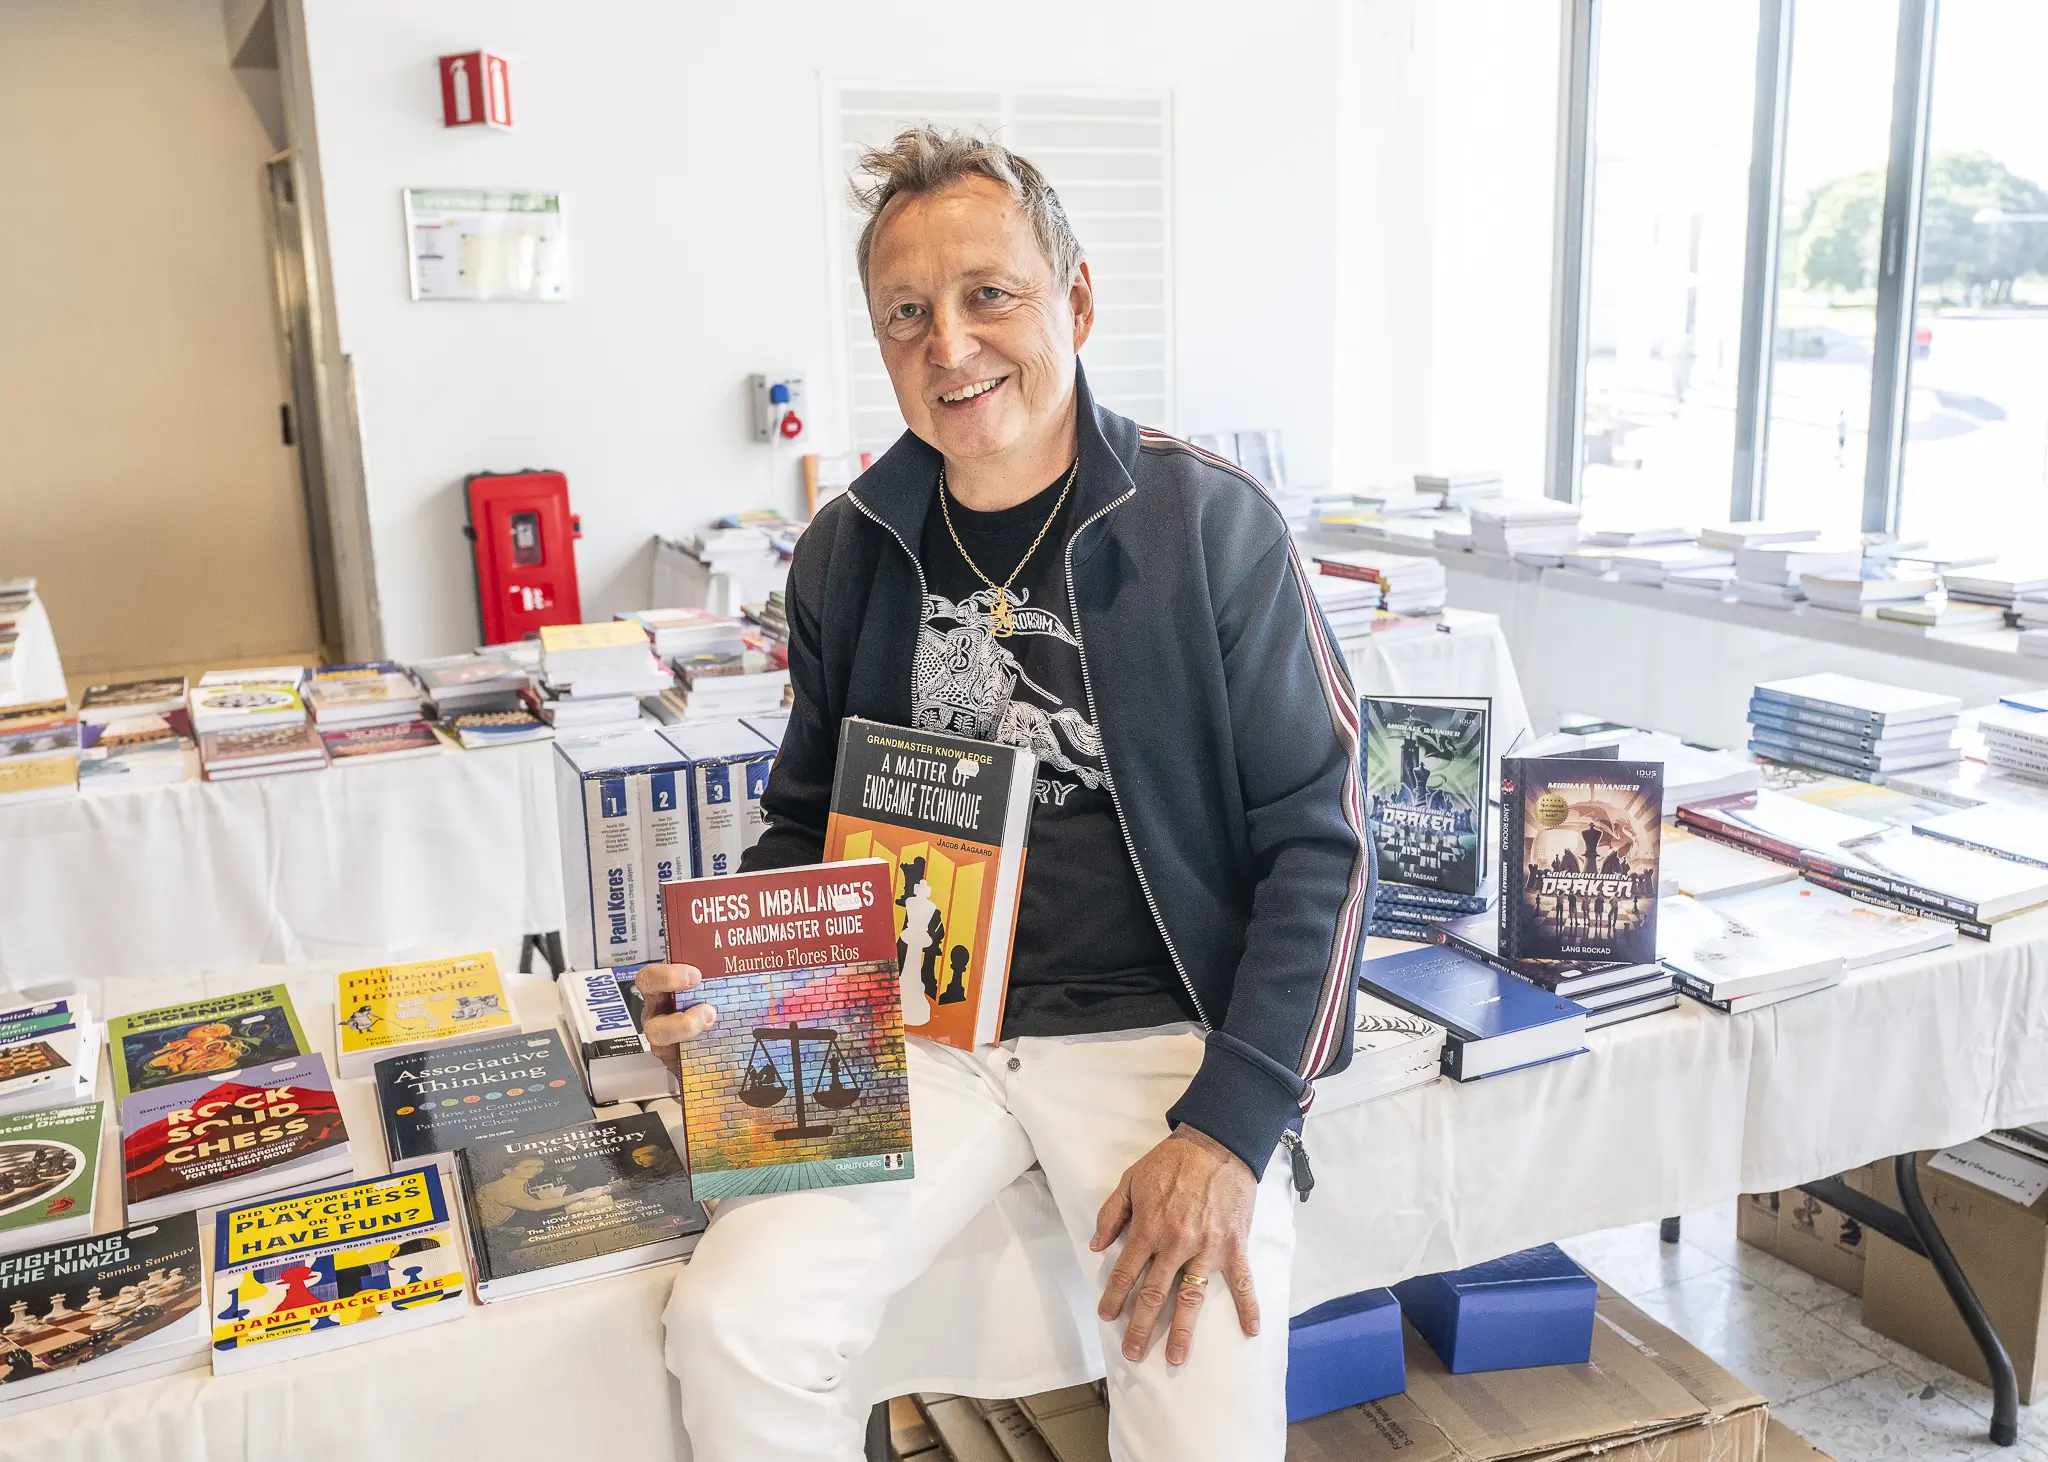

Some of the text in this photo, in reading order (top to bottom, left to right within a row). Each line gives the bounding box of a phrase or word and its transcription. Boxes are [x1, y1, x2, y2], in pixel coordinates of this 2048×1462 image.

[1003, 611, 1053, 632] RORSUM
[1387, 722, 1461, 738] MICHAEL WIANDER
[867, 734, 993, 765] GRANDMASTER KNOWLEDGE
[881, 752, 890, 772] A
[895, 755, 947, 784] MATTER
[658, 791, 669, 808] 2
[713, 784, 724, 801] 3
[753, 779, 764, 795] 4
[1547, 782, 1640, 792] MICHAEL WIANDER
[607, 797, 618, 814] 1
[862, 775, 982, 830] ENDGAME TECHNIQUE
[1382, 808, 1455, 833] DRAKEN
[625, 862, 633, 882] players
[1404, 871, 1438, 883] EN PASSANT
[626, 883, 634, 898] chess
[1398, 893, 1427, 902] MICHAEL
[1541, 878, 1634, 898] DRAKEN
[1844, 868, 1891, 892] Understanding
[1890, 882, 1909, 896] Rook
[1909, 888, 1945, 907] Endgames
[607, 868, 628, 945] Paul Keres
[628, 899, 636, 913] other
[691, 893, 750, 925] CHESS
[1392, 910, 1421, 919] MICHAEL
[1851, 890, 1956, 925] Understanding Rook Endgames
[714, 915, 864, 949] A GRANDMASTER GUIDE
[1392, 928, 1421, 937] MICHAEL
[724, 944, 860, 974] Mauricio Flores Rios
[1562, 945, 1611, 955] LÅNG ROCKAD
[348, 962, 489, 989] Philosopher
[375, 978, 439, 992] and the
[352, 980, 480, 1003] Housewife
[584, 973, 623, 1007] Keres
[127, 989, 273, 1023] LEARN FROM THE
[127, 1000, 256, 1029] LEGENDS
[590, 1004, 633, 1032] Paul
[393, 1050, 551, 1085] Associative
[395, 1052, 448, 1066] MIKHAIL
[407, 1065, 548, 1096] Thinking
[12, 1104, 97, 1122] Chess Oing
[35, 1109, 97, 1123] Repire
[139, 1101, 176, 1115] Sergei
[167, 1085, 298, 1127] ROCK
[415, 1099, 561, 1132] Patterns and Creativity
[432, 1097, 539, 1121] How to Connect
[36, 1114, 96, 1129] Dragon
[167, 1102, 301, 1145] SOLID
[463, 1116, 520, 1131] in Chess
[164, 1117, 309, 1165] CHESS
[504, 1124, 618, 1155] Unveiling
[536, 1128, 648, 1156] the Victory
[170, 1158, 215, 1174] Tiviakov's
[180, 1160, 223, 1177] VOLUME
[236, 1140, 297, 1165] SEARCHING
[185, 1148, 293, 1181] FOR THE RIGHT MOVE
[554, 1146, 622, 1165] HENRI SERRUYS
[835, 1159, 882, 1171] QUALITY CHESS
[236, 1186, 421, 1235] PLAY CHESS
[237, 1209, 263, 1221] DID
[268, 1201, 299, 1215] YOU
[304, 1192, 349, 1207] COME
[353, 1184, 394, 1197] HE
[542, 1199, 644, 1226] HOW SPASSKY WON
[241, 1208, 422, 1256] HAVE FUN?
[308, 1213, 353, 1227] OR TO
[526, 1201, 662, 1237] The Third World Junior Chess
[527, 1224, 597, 1243] Championship
[597, 1215, 639, 1234] Antwerp
[639, 1208, 665, 1221] 1955
[0, 1235, 123, 1276] FIGHTING
[97, 1246, 195, 1281] Semko Semkov
[227, 1225, 438, 1276] And other tales from 'Dana blogs chess'
[0, 1248, 130, 1290] THE NIMZO
[233, 1278, 445, 1334] DANA MACKENZIE
[245, 1334, 265, 1344] NEW
[276, 1326, 303, 1338] CHESS
